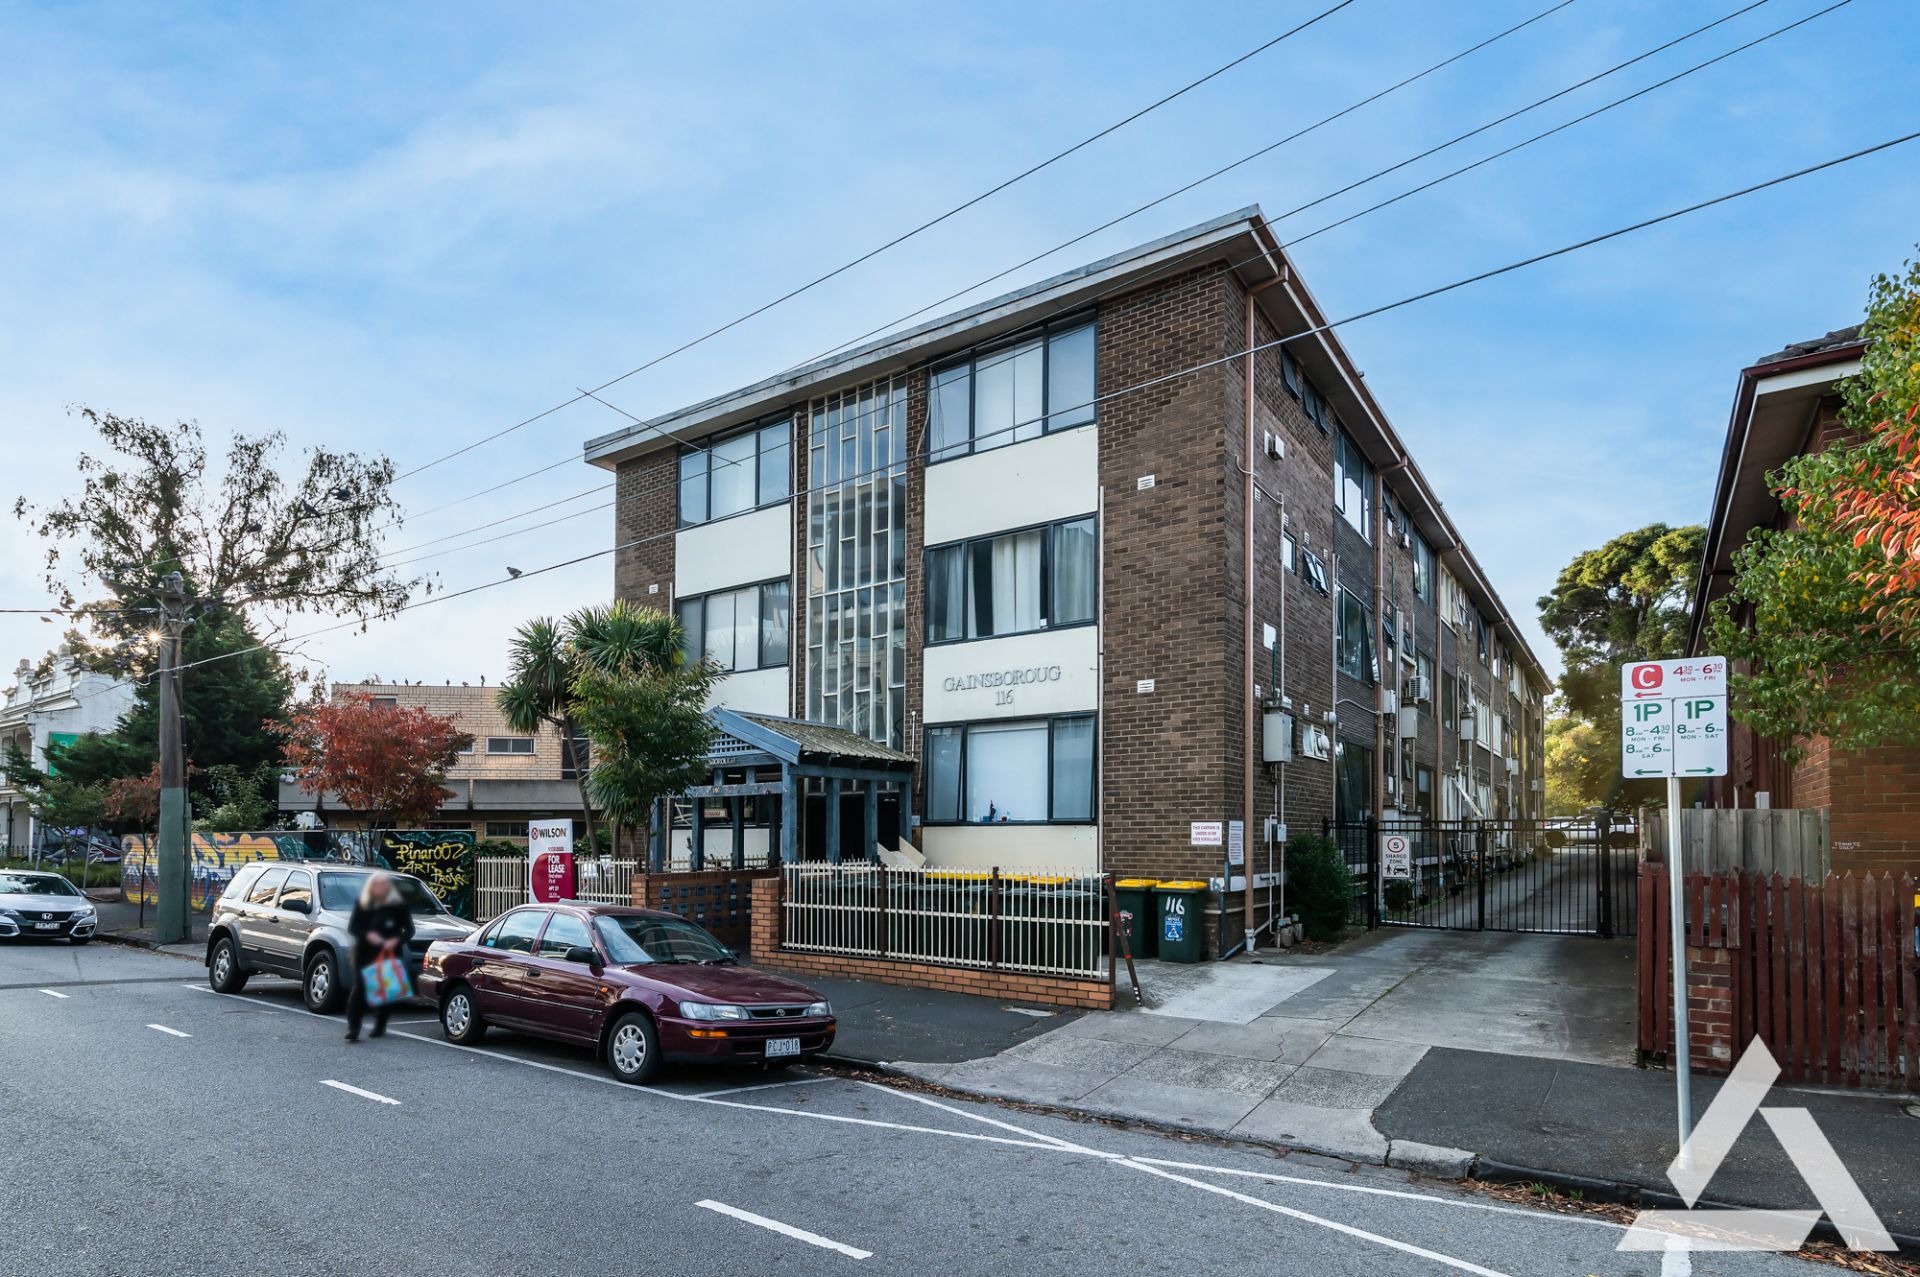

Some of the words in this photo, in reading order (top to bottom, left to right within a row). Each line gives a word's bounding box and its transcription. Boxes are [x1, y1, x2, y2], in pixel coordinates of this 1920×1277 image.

[943, 665, 1061, 692] GAINSBOROUG
[1638, 667, 1656, 687] C
[995, 689, 1014, 706] 116
[1634, 703, 1662, 722] 1P
[1684, 700, 1714, 720] 1P
[539, 828, 567, 838] WILSON
[548, 855, 560, 864] FOR
[548, 864, 566, 874] LEASE
[1165, 896, 1185, 915] 116
